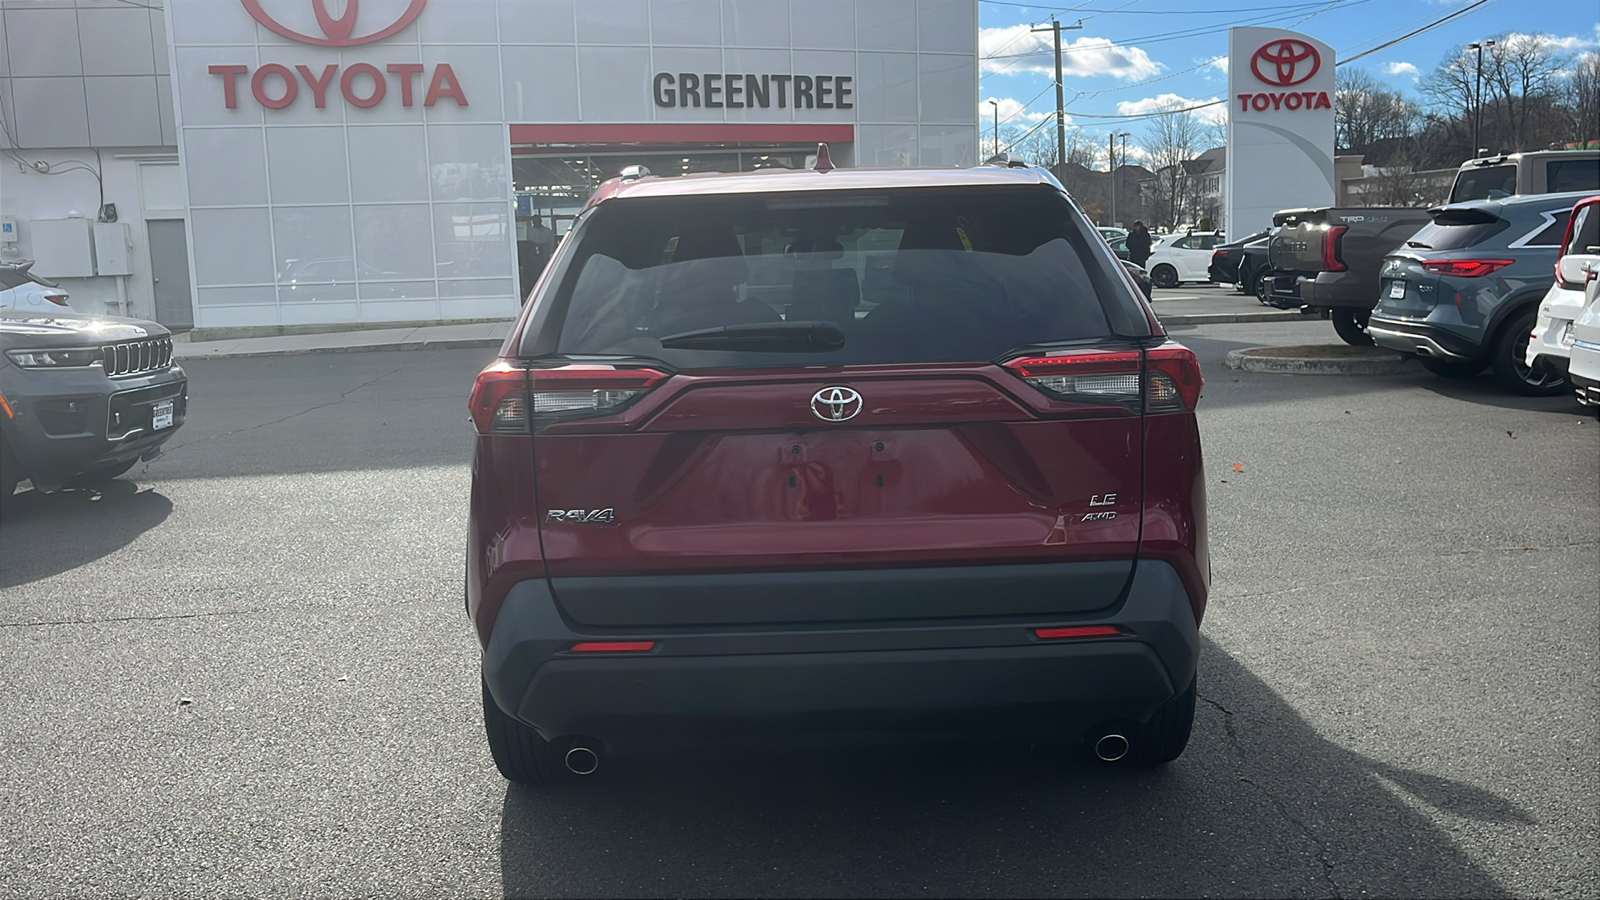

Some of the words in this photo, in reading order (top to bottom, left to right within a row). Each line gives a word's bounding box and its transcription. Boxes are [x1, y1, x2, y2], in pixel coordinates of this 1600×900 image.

[208, 63, 469, 109] TOYOTA
[653, 72, 853, 109] GREENTREE
[1237, 92, 1332, 112] TOYOTA
[1340, 215, 1365, 223] TRD
[1089, 493, 1117, 506] LE
[546, 508, 614, 523] RAV4
[1081, 511, 1117, 522] AWD
